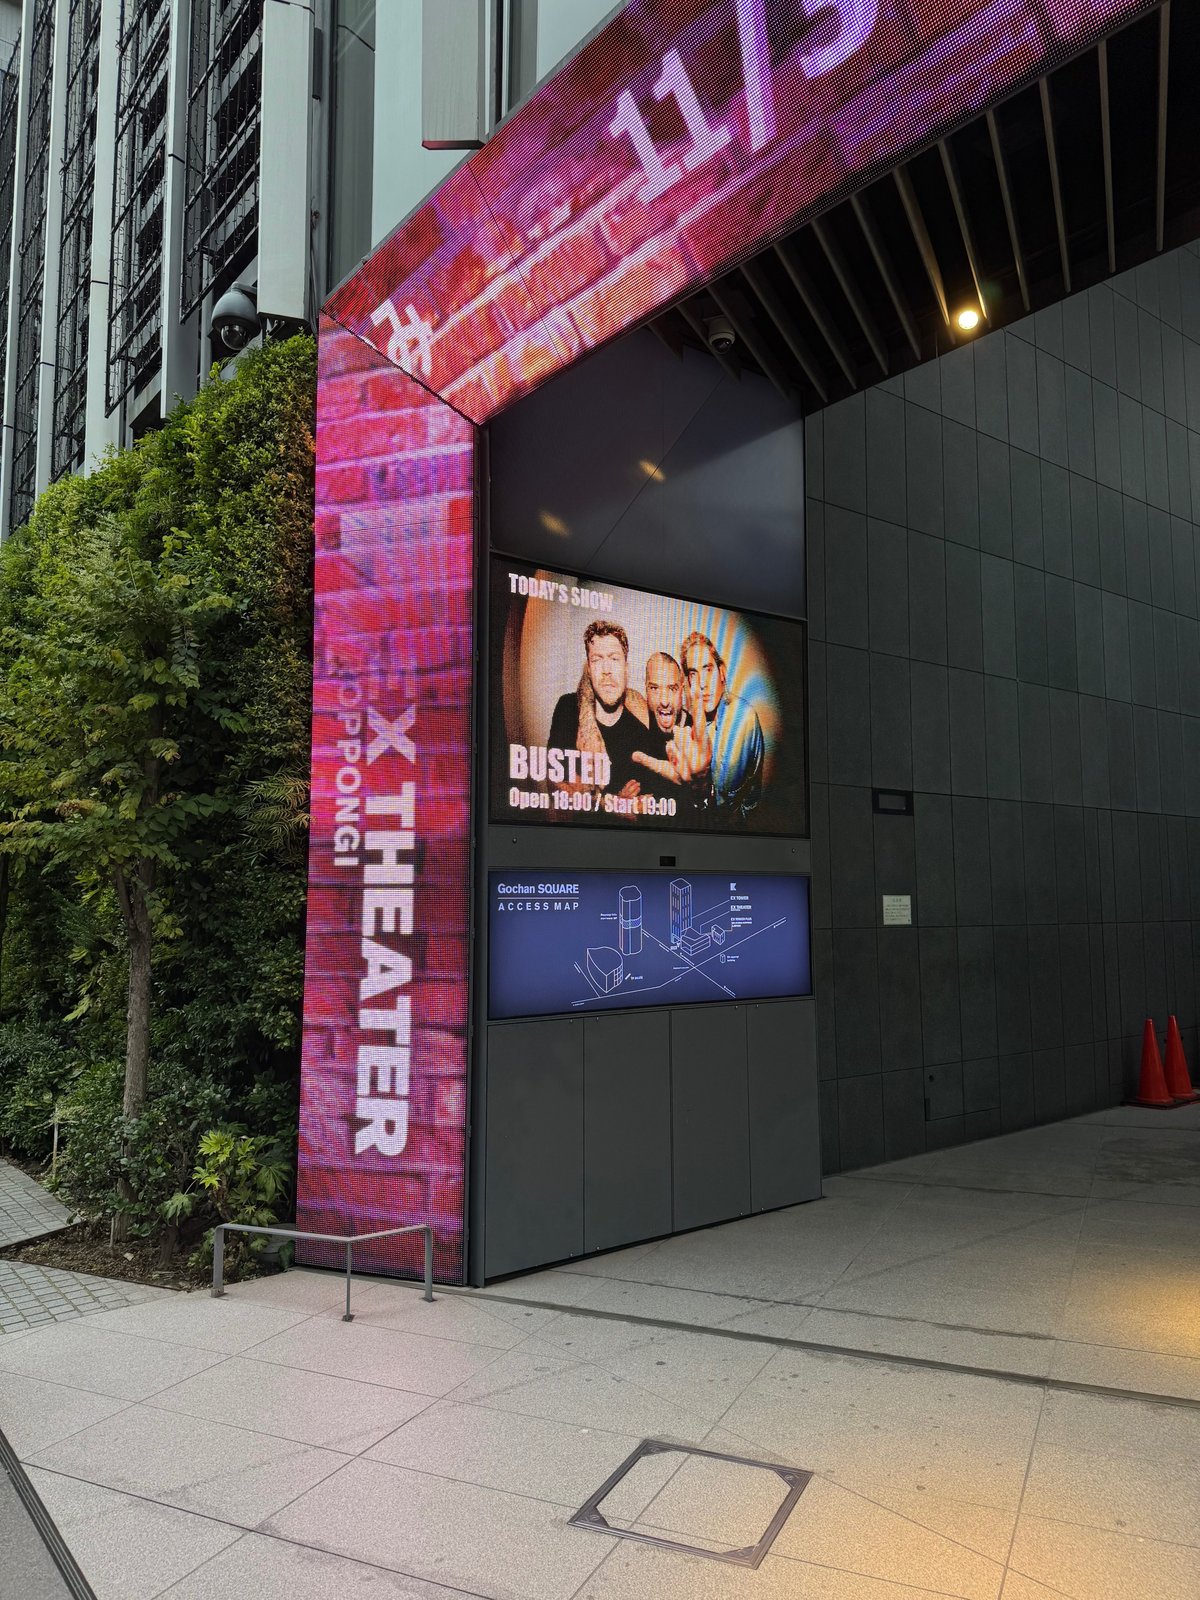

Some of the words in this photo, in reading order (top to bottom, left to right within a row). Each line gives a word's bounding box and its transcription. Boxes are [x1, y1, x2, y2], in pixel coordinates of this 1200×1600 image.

[509, 573, 568, 604] TODAY'S
[571, 586, 613, 612] SHOW
[510, 744, 611, 786] BUSTED
[509, 787, 549, 809] Open
[552, 790, 591, 811] 18:00
[604, 793, 640, 814] Start
[642, 796, 677, 816] 19:00
[498, 883, 535, 894] Gochan
[538, 884, 579, 894] SQUARE
[498, 902, 549, 911] ACCESS
[554, 902, 579, 911] MAP
[355, 781, 416, 1155] THEATER
